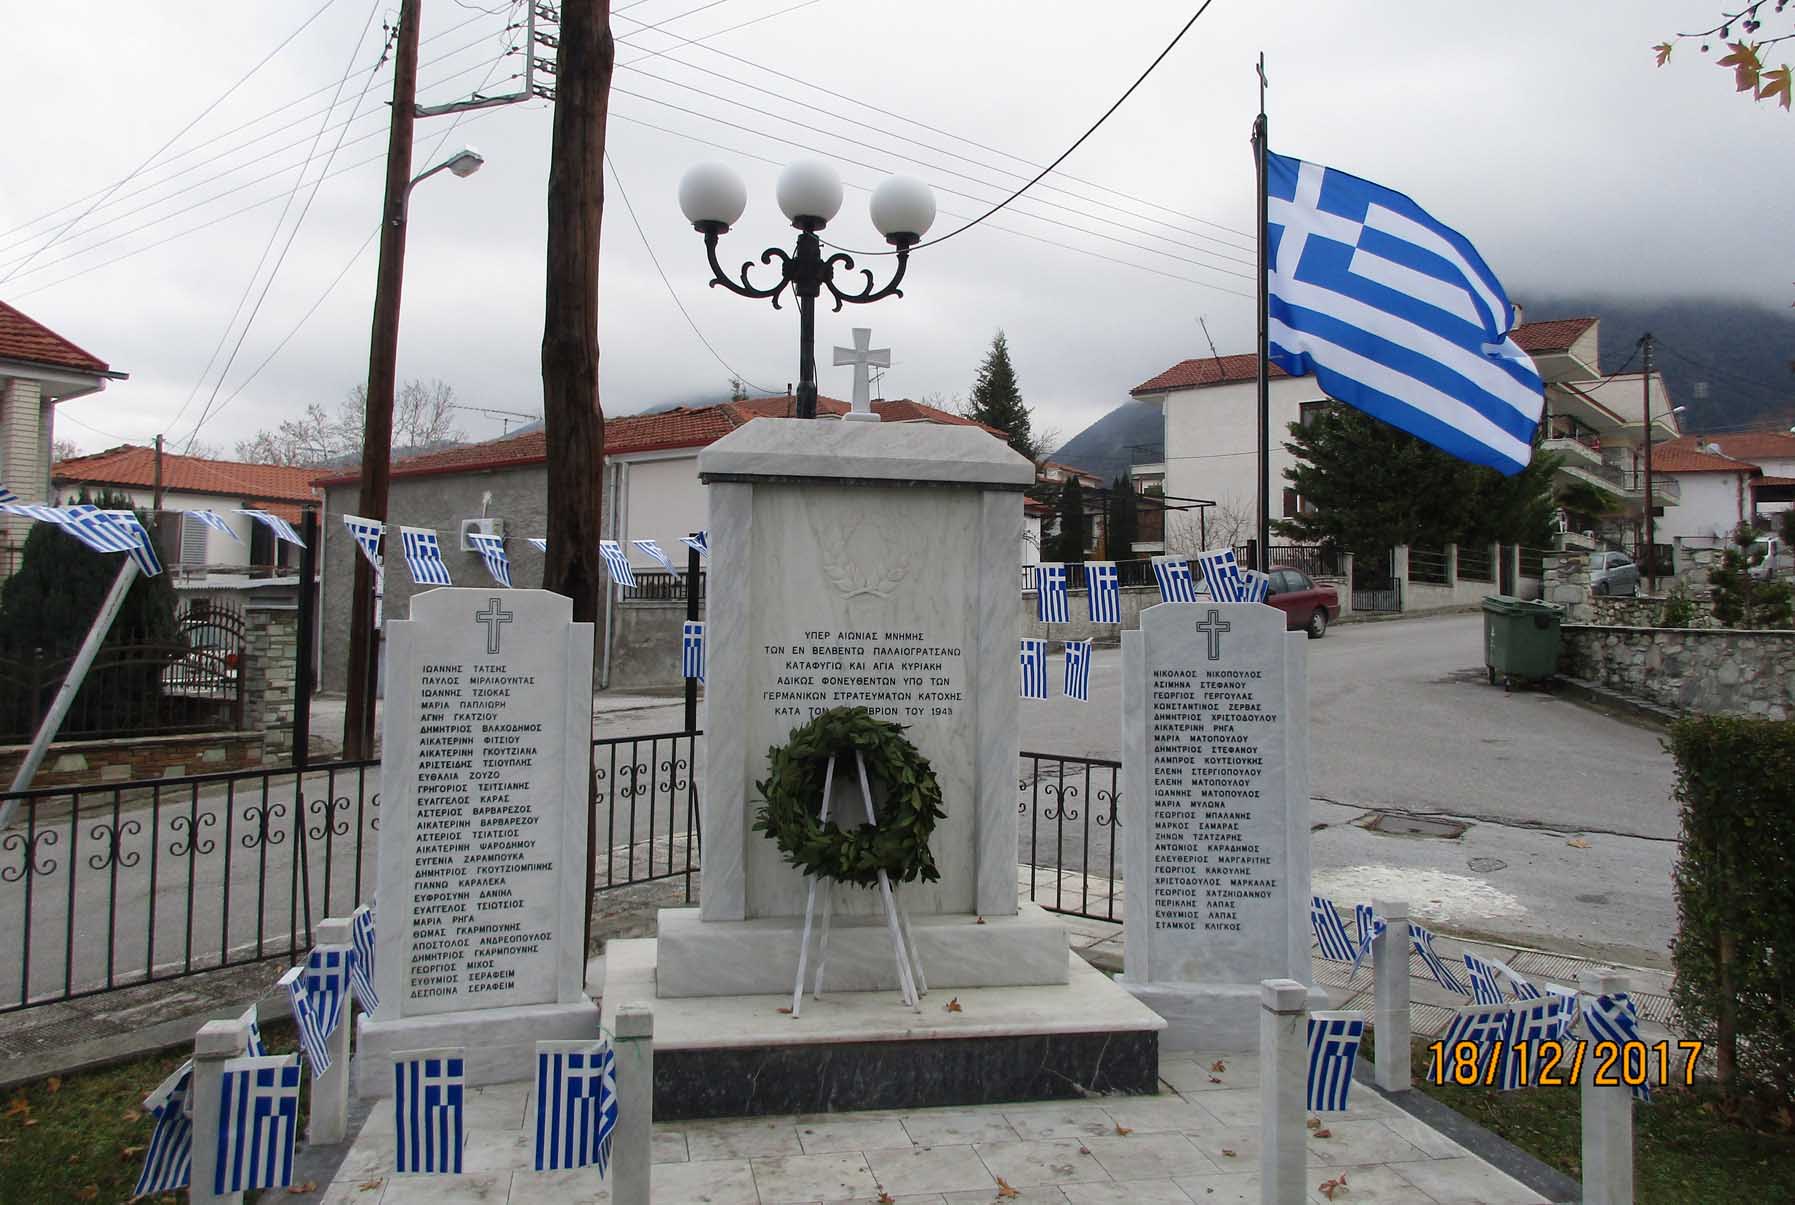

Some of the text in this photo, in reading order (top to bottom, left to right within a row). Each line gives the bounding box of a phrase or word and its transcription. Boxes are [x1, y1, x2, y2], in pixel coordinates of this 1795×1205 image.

[804, 631, 925, 641] ΥΠΕΡ ΑΙΩΝΙΑΣ ΜΝΗΜΗΣ
[764, 645, 961, 657] ΤΩΝ ΕΝ ΒΕΛΒΕΝΤΩ ΠΑΛΑΙΟΓΡΑΤΣΑΝΩ
[422, 664, 508, 674] ΙΩΑΝΝΗΣ ΤΑΤΣΗΣ
[785, 660, 942, 671] ΚΑΤΑΦΥΓΙΩ ΚΑΙ ΑΓΙΑ ΚΥΡΙΑΚΗ
[1153, 669, 1263, 679] ΝΙΚΟΛΑΟΣ ΝΙΚΟΠΟΥΛΟΣ
[422, 676, 460, 685] ΠΑΥΛΟΣ
[777, 676, 951, 687] ΑΔΙΚΩΣ ΦΟΝΕΥΘΕΝΤΩΝ ΥΠΟ ΤΩΝ
[1153, 680, 1247, 689] ΑΣΙΜΗΝΑ ΣΤΕΦΑΝΟΥ
[421, 688, 511, 698] ΙΩΑΝΝΗΣ ΤΖΙΟΚΑΣ
[763, 691, 963, 701] ΓΕΡΜΑΝΙΚΩΝ ΣΤΡΑΤΕΥΜΑΤΩΝ ΚΑΤΟΧΗΣ
[1153, 691, 1254, 701] ΓΕΩΡΓΙΟΣ ΓΕΡΓΟΥΛΑΣ
[421, 700, 507, 710] ΜΑΡΙΑ ΠΑΠΛΙΩΡΗ
[1153, 702, 1263, 712] ΚΩΝΣΤΑΝΤΙΝΟΣ ΖΕΡΒΑΣ
[774, 706, 801, 716] ΚΑΤΑ
[904, 707, 925, 716] ΤΟΥ
[931, 707, 953, 716] 1943
[419, 712, 498, 722] ΑΓΝΗ ΓΚΑΤΖΙΟΥ
[1154, 713, 1278, 723] ΔΗΜΗΤΡΙΟΣ ΧΡΙΣΤΟΔΟΥΛΟΥ
[419, 723, 543, 735] ΔΗΜΗΤΡΙΟΣ ΒΛΑΧΟΔΗΜΟΣ
[1154, 723, 1235, 733] ΑΙΚΑΤΕΡΙΝΗ ΡΗΓΑ
[419, 735, 521, 747] ΑΙΚΑΤΕΡΙΝΗ ΦΙΤΣΙΟΥ
[1154, 734, 1249, 744] ΜΑΡΙΑ ΜΑΤΟΠΟΥΛΟΥ
[419, 747, 538, 758] ΑΙΚΑΤΕΡΙΝΗ ΓΚΟΥΤΖΙΑΝΑ
[1154, 745, 1259, 754] ΔΗΜΗΤΡΙΟΣ ΣΤΕΦΑΝΟΥ
[418, 758, 533, 770] ΑΡΙΣΤΕΙΔΗΣ ΤΣΙΟΥΠΛΗΣ
[1154, 756, 1264, 766] ΛΑΜΠΡΟΣ ΚΟΥΤΣΙΟΥΚΗΣ
[418, 770, 501, 782] ΕΥΘΑΛΙΑ ΖΟΥΖΟ
[1154, 767, 1262, 777] ΕΛΕΝΗ ΣΤΕΡΓΙΟΠΟΥΛΟΥ
[417, 781, 531, 794] ΓΡΗΓΟΡΙΟΣ ΤΣΙΤΣΙΑΝΗΣ
[1154, 778, 1251, 787] ΕΛΕΝΗ ΜΑΤΟΠΟΥΛΟΥ
[1154, 788, 1261, 799] ΙΩΑΝΝΗΣ ΜΑΤΟΠΟΥΛΟΣ
[417, 794, 510, 807] ΕΥΑΓΓΕΛΟΣ ΚΑΡΑΣ
[1154, 799, 1226, 809] ΜΑΡΙΑ ΜΥΛΩΝΑ
[416, 804, 533, 819] ΑΣΤΕΡΙΟΣ ΒΑΡΒΑΡΕΖΟΣ
[1154, 811, 1252, 820] ΓΕΩΡΓΙΟΣ ΜΠΑΛΑΝΗΣ
[416, 816, 540, 830] ΑΙΚΑΤΕΡΙΝΗ ΒΑΡΒΑΡΕΖΟΥ
[1155, 821, 1240, 831] ΜΑΡΚΟΣ ΣΑΜΑΡΑΣ
[416, 831, 463, 843] ΑΣΤΕΡΙΟΣ
[1155, 832, 1243, 842] ΖΗΝΩΝ ΤΖΑΤΖΑΡΗΣ
[415, 839, 536, 855] ΑΙΚΑΤΕΡΙΝΗ ΨΑΡΟΔΗΜΟΥ
[1154, 843, 1260, 853] ΑΝΤΩΝΙΟΣ ΚΑΡΑΔΗΜΟΣ
[415, 852, 525, 867] ΕΥΓΕΝΙΑ ΖΑΡΑΜΠΟΥΚΑ
[1155, 854, 1272, 865] ΕΛΕΥΘΕΡΙΟΣ ΜΑΡΓΑΡΙΤΗΣ
[415, 867, 468, 879] ΔΗΜΗΤΡΙΟΣ
[1155, 865, 1252, 876] ΓΕΩΡΓΙΟΣ ΚΑΚΟΥΛΗΣ
[414, 877, 507, 891] ΓΙΑΝΝΩ ΚΑΡΑΛΕΚΑ
[1155, 877, 1277, 888] ΧΡΙΣΤΟΔΟΥΛΟΣ ΜΑΡΚΑΛΑΣ
[414, 888, 513, 903] ΕΥΦΡΟΣΥΝΗ ΔΑΝΙΗΛ
[1155, 888, 1197, 897] ΓΕΩΡΓΙΟΣ
[413, 903, 467, 916] ΕΥΑΓΓΕΛΟΣ
[1155, 899, 1236, 909] ΠΕΡΙΚΛΗΣ ΛΑΠΑΣ
[1155, 910, 1238, 920] ΕΥΘΥΜΙΟΣ ΛΑΠΑΣ
[413, 914, 475, 928] ΜΑΡΙΑ ΡΗΓΑ
[412, 922, 521, 939] ΘΩΜΑΣ ΓΚΑΡΜΠΟΥΝΗΣ
[412, 938, 470, 951] ΑΠΟΣΤΟΛΟΣ
[411, 944, 539, 964] ΔΗΜΗΤΡΙΟΣ ΓΚΑΡΜΠΟΥΝΗΣ
[411, 959, 495, 975] ΓΕΩΡΓΙΟΣ ΜΙΧΟΣ
[411, 968, 516, 988] ΕΥΘΥΜΙΟΣ ΣΕΡΑΦΕΙΜ
[410, 980, 515, 999] ΔΕΣΠΟΙΝΑ ΣΕΡΑΦΕΙΜ
